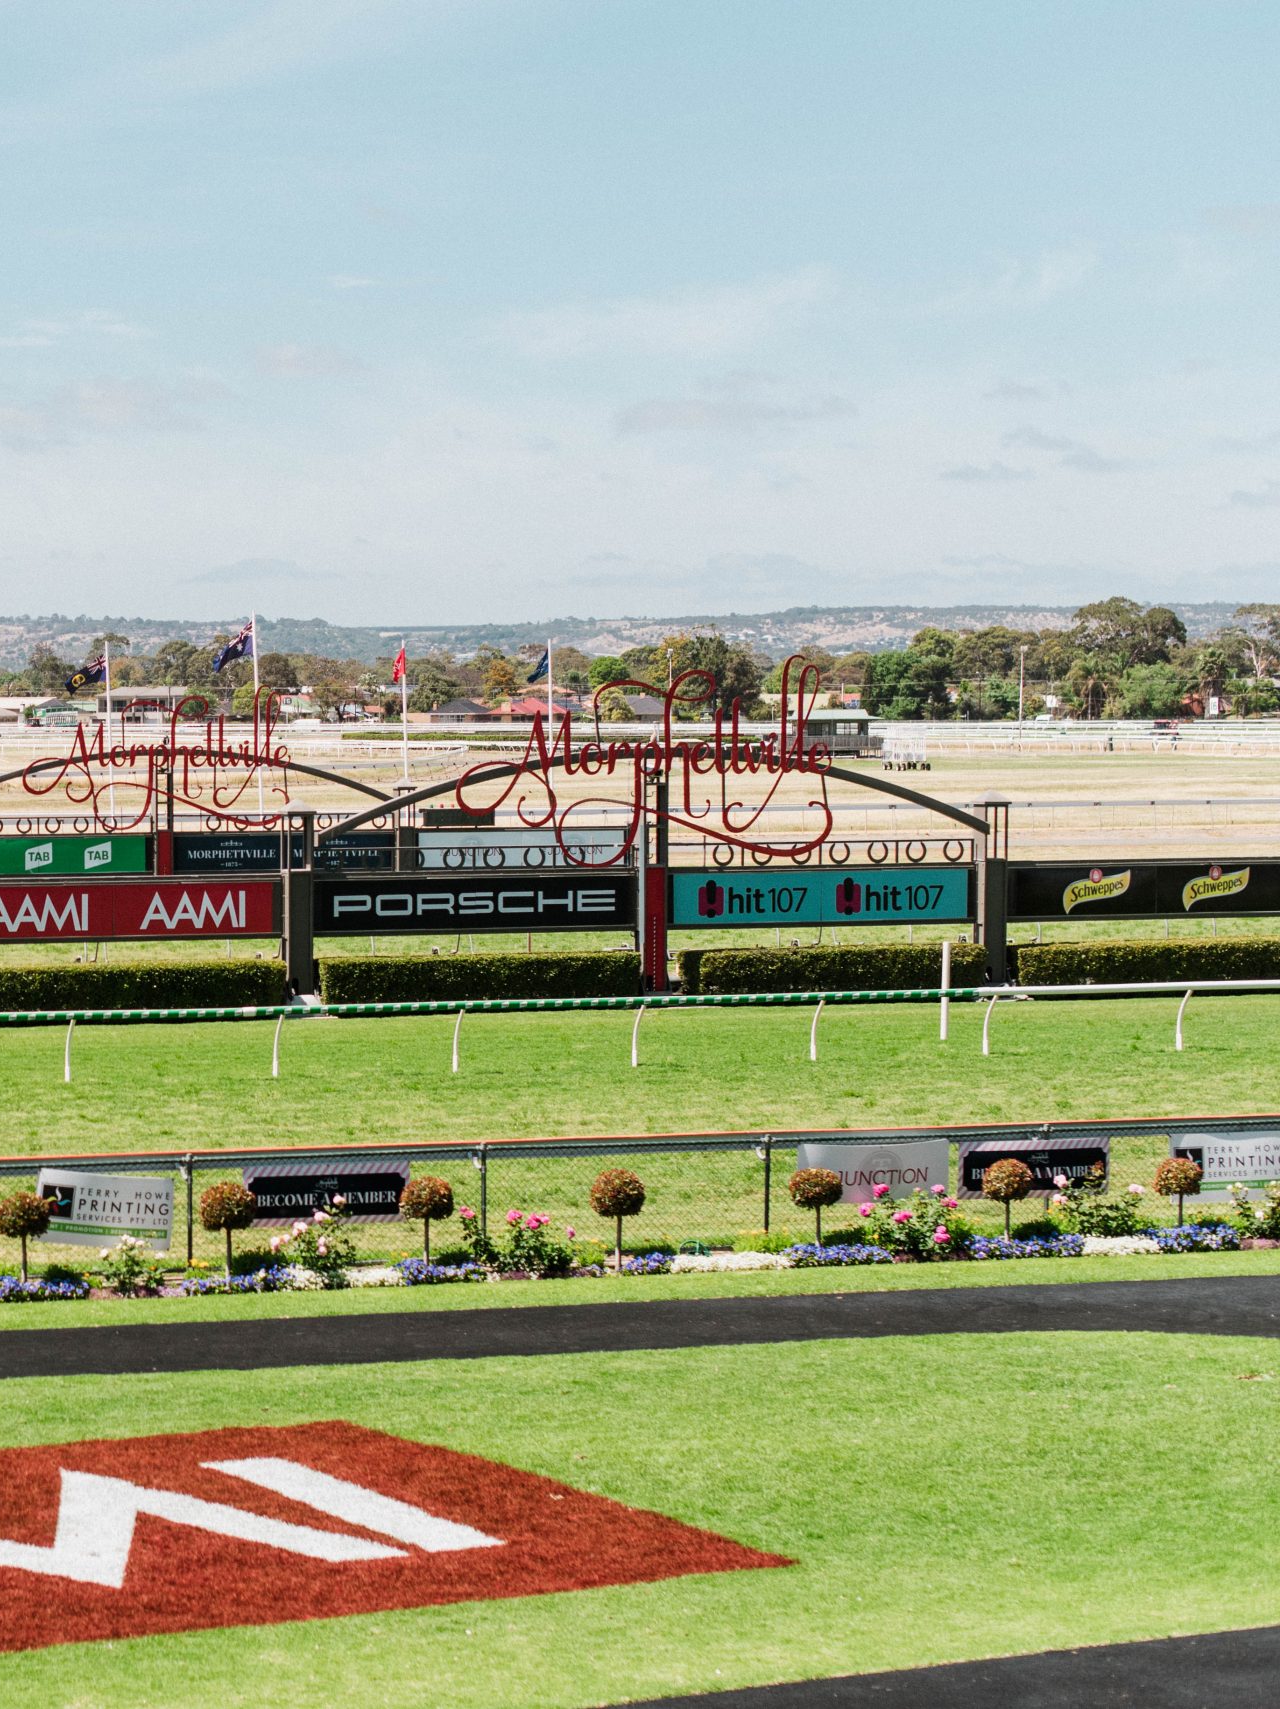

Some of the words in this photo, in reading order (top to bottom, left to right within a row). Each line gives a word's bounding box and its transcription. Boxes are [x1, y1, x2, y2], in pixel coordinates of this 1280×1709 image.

[22, 685, 291, 830] Morphettville
[456, 654, 834, 868] Morphettville
[28, 851, 50, 862] TAB
[87, 850, 109, 861] TAB
[187, 848, 276, 859] MORPHETTVILLE
[1070, 878, 1124, 903] Schweppes
[1190, 876, 1242, 900] Schweppes
[140, 890, 247, 930] AAMI
[333, 889, 616, 918] PORSCHE
[1207, 1146, 1240, 1154] TERRY
[1255, 1144, 1280, 1152] HOW
[1208, 1155, 1280, 1168] PRINTIN
[1208, 1169, 1248, 1178] SERVICES
[80, 1187, 120, 1199] TERRY
[135, 1191, 170, 1201] HOWE
[257, 1192, 318, 1208] BECOME
[321, 1194, 331, 1206] A
[78, 1199, 170, 1216] PRINTING
[76, 1213, 122, 1224] SERVICES
[130, 1217, 145, 1225] PTY
[153, 1218, 169, 1226] LTD
